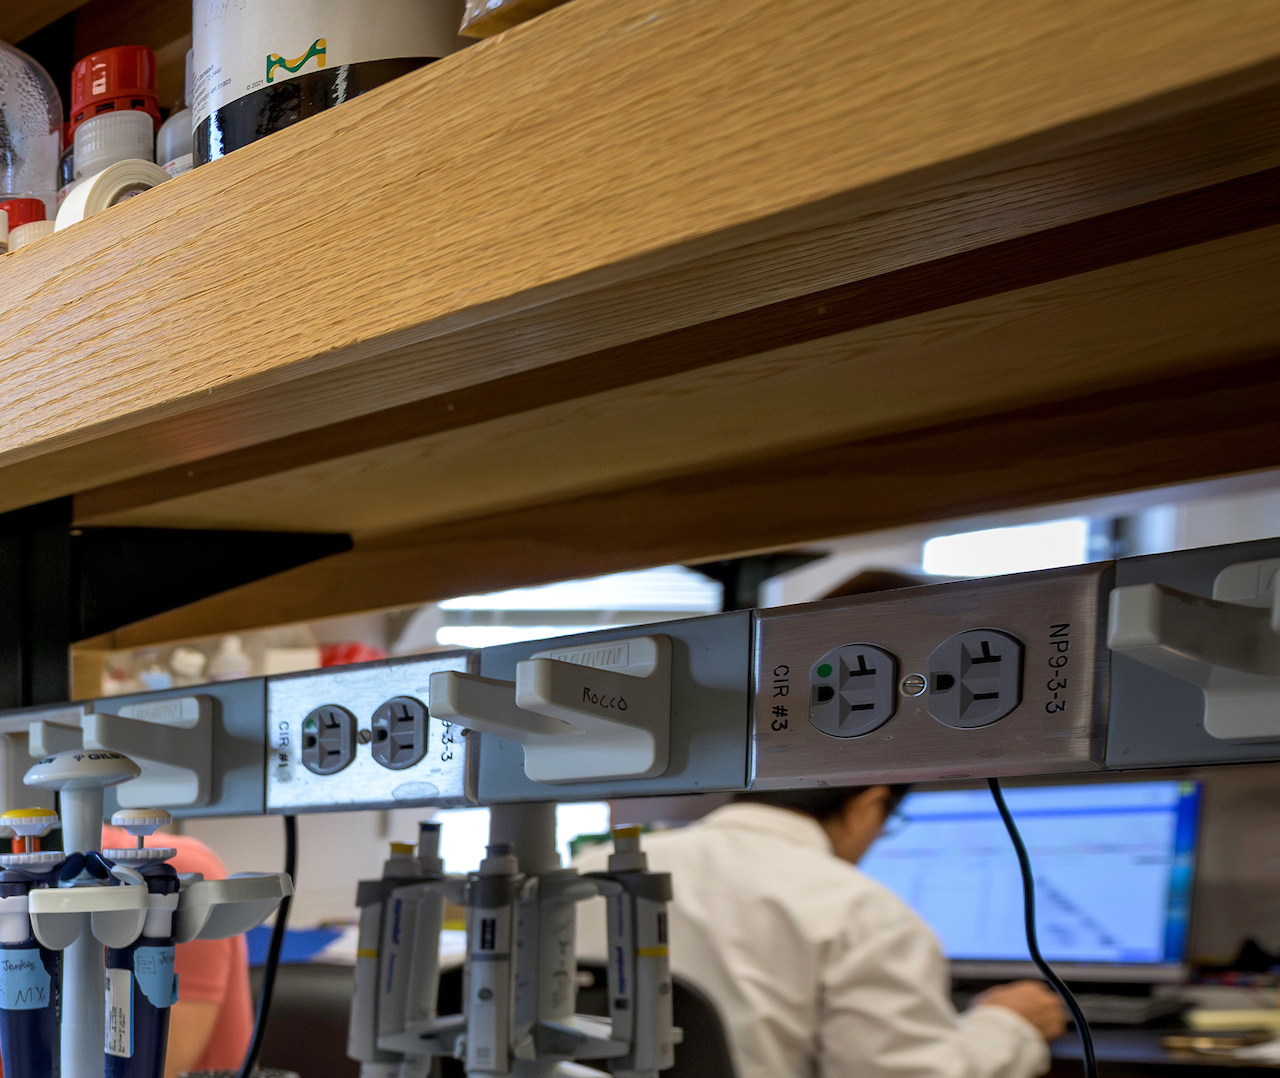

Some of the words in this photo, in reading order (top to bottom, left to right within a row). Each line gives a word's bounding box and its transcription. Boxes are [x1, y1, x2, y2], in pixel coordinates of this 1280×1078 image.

[771, 664, 790, 698] CIR
[1045, 623, 1070, 714] NP9-3-3
[770, 704, 789, 732] #3
